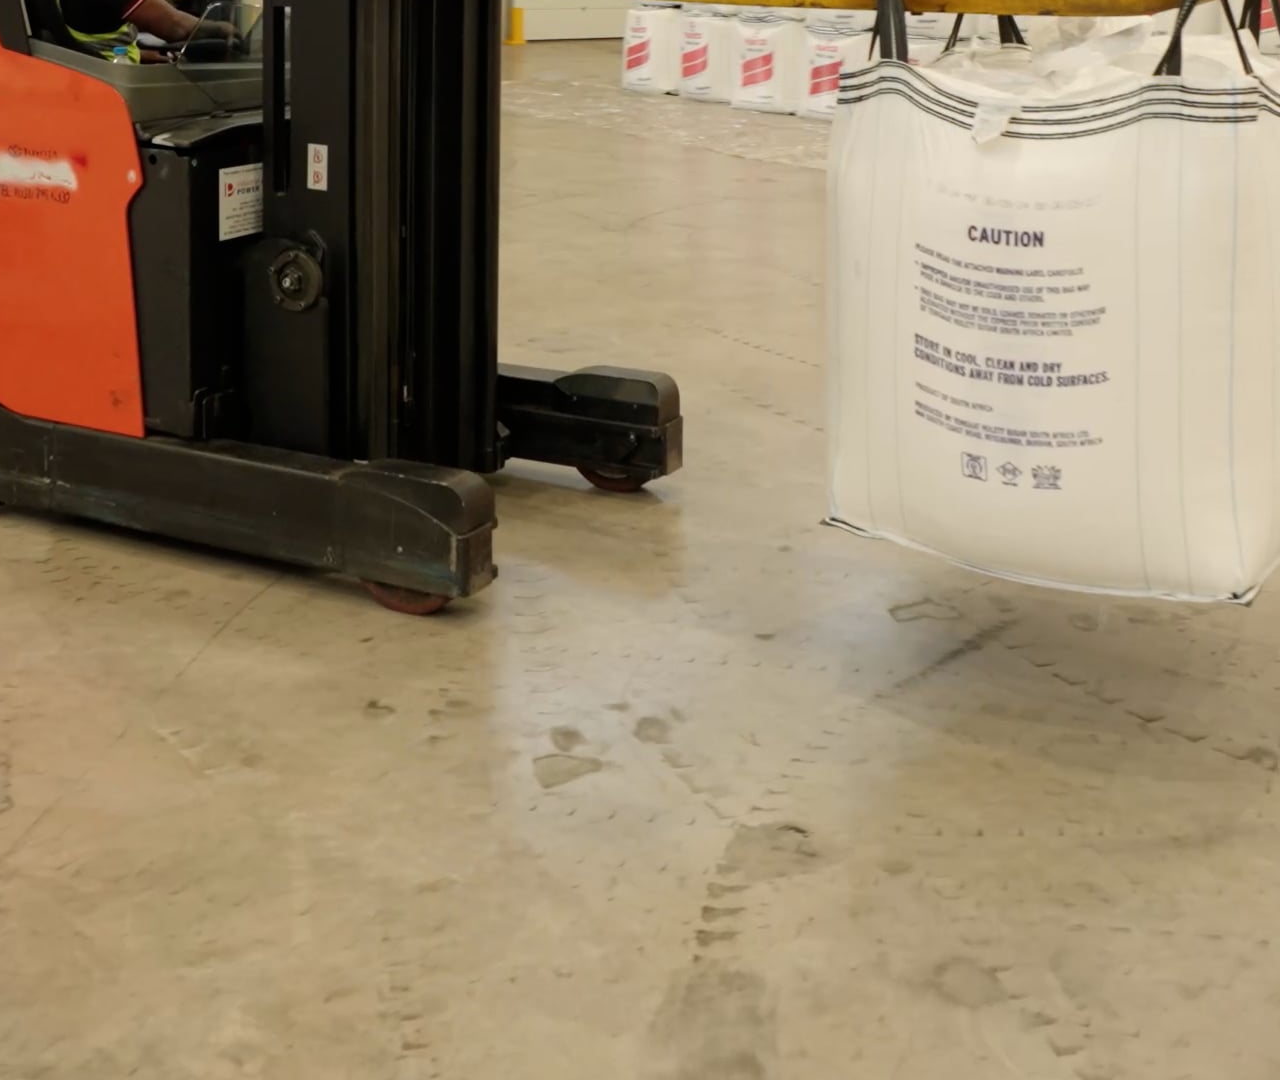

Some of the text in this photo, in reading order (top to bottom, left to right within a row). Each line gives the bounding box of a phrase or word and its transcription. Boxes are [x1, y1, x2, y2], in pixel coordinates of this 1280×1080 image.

[968, 225, 1044, 247] CAUTION
[915, 333, 940, 354] STORE
[943, 345, 952, 359] IN
[985, 357, 1015, 371] CLEAN
[1019, 362, 1039, 373] AND
[1043, 362, 1062, 373] DRY
[915, 347, 1110, 387] CONDITIONS AWAY FROM COLD SURFACES.
